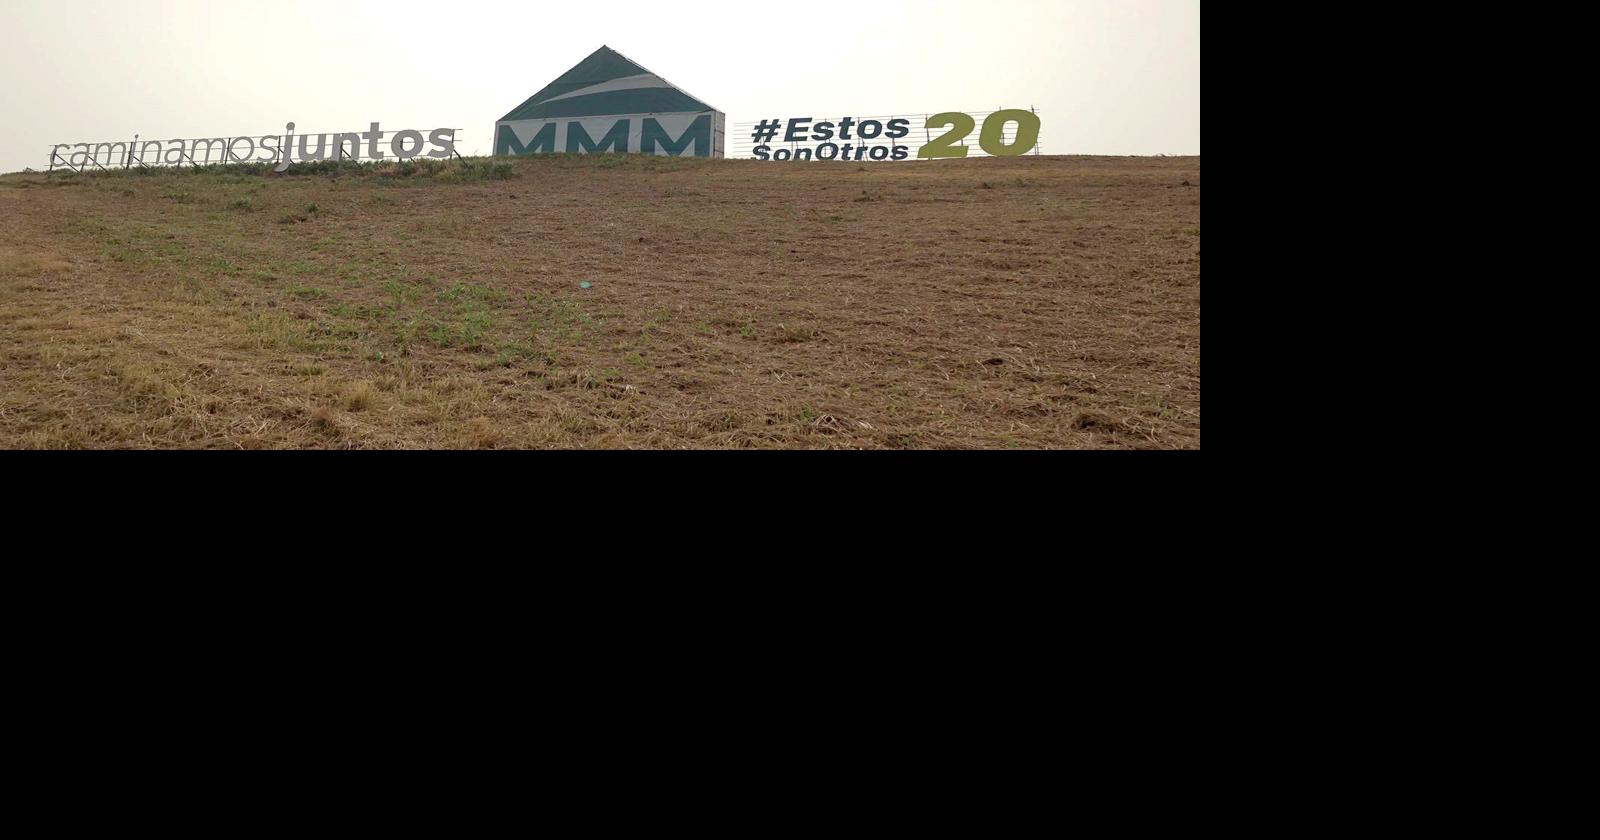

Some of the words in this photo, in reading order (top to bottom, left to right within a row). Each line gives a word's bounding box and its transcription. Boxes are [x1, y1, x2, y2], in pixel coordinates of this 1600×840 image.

[496, 115, 711, 156] MMM
[751, 117, 910, 143] #Estos
[917, 108, 1042, 158] 20
[752, 142, 909, 161] SonOtros
